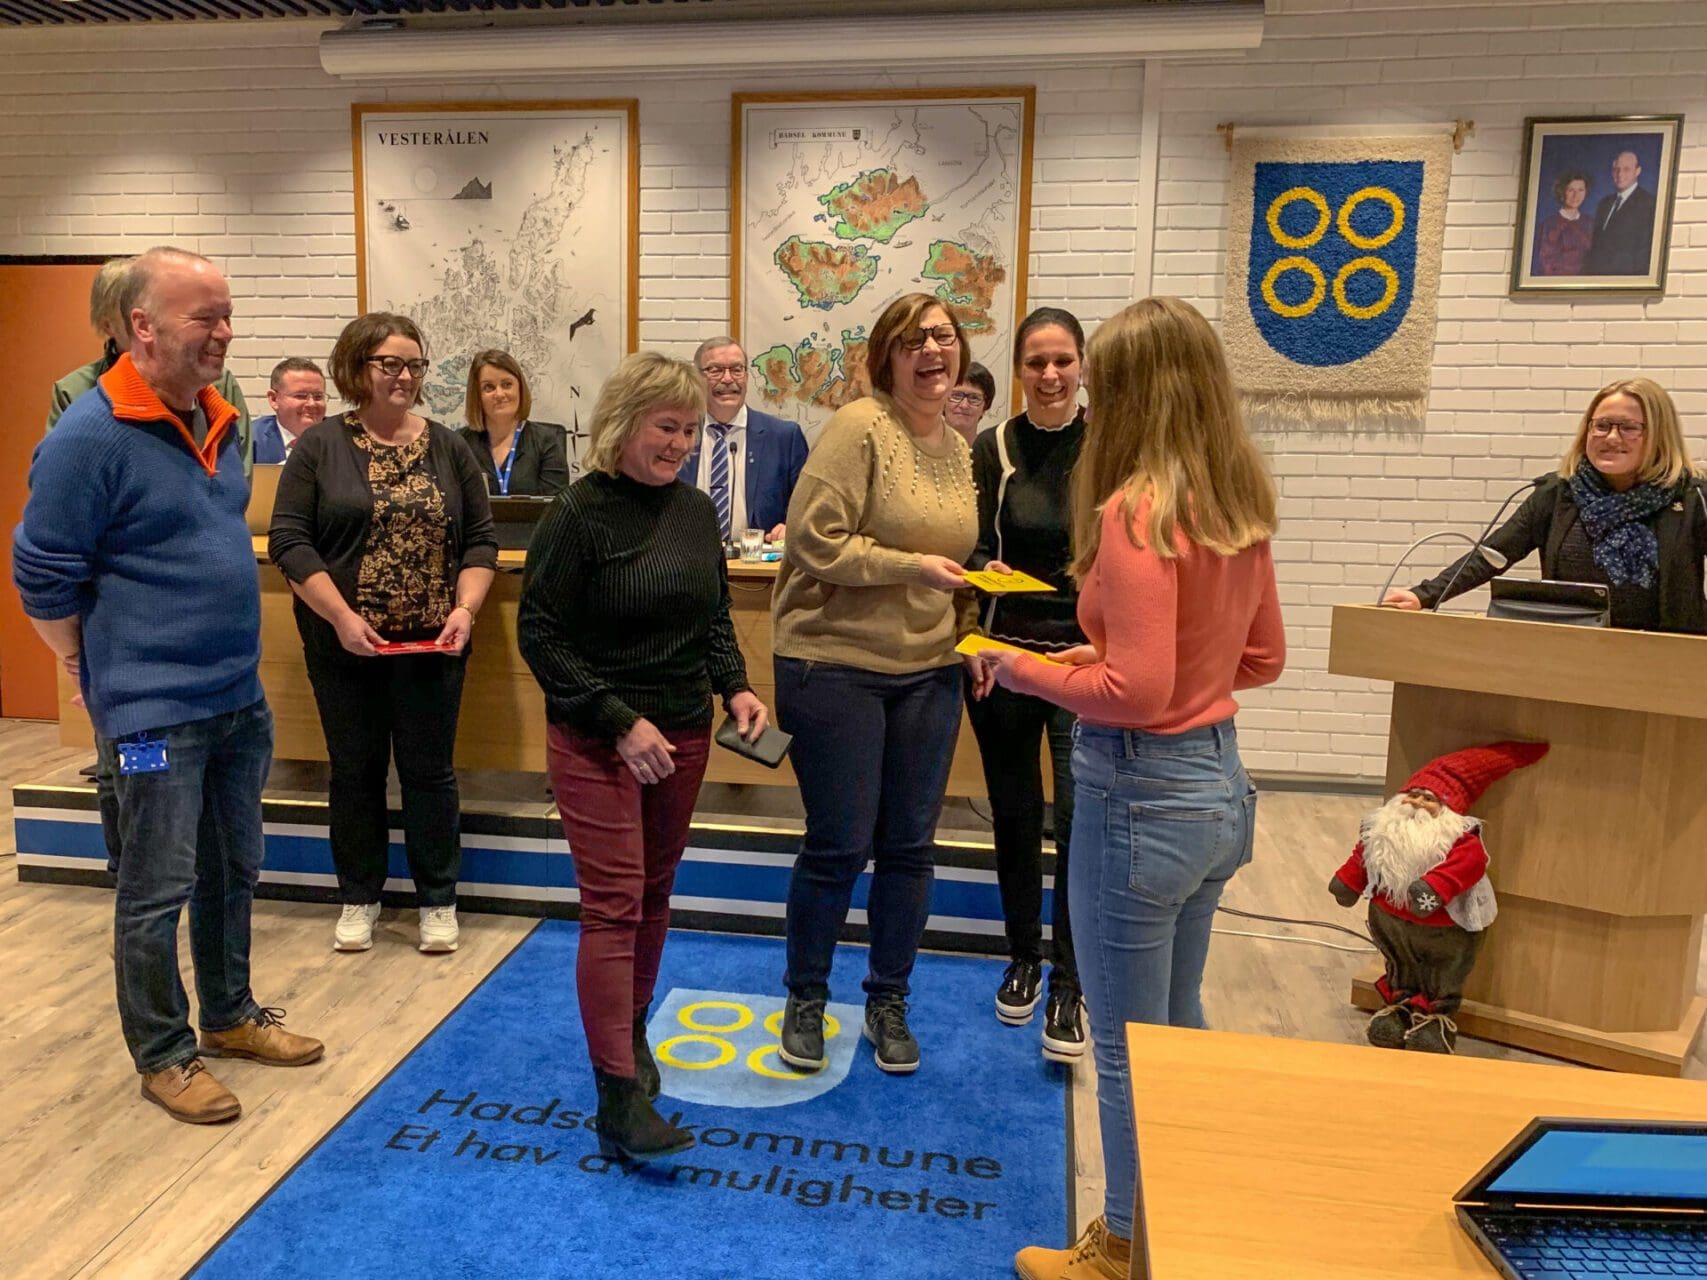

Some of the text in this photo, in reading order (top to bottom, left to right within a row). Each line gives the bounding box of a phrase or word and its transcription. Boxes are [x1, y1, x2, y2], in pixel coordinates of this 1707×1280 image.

[378, 129, 489, 146] VESTERÅLEN
[570, 386, 581, 399] N
[571, 461, 580, 474] S
[384, 1123, 441, 1153] Et
[453, 1129, 561, 1166] hav
[671, 1164, 998, 1221] muligheter
